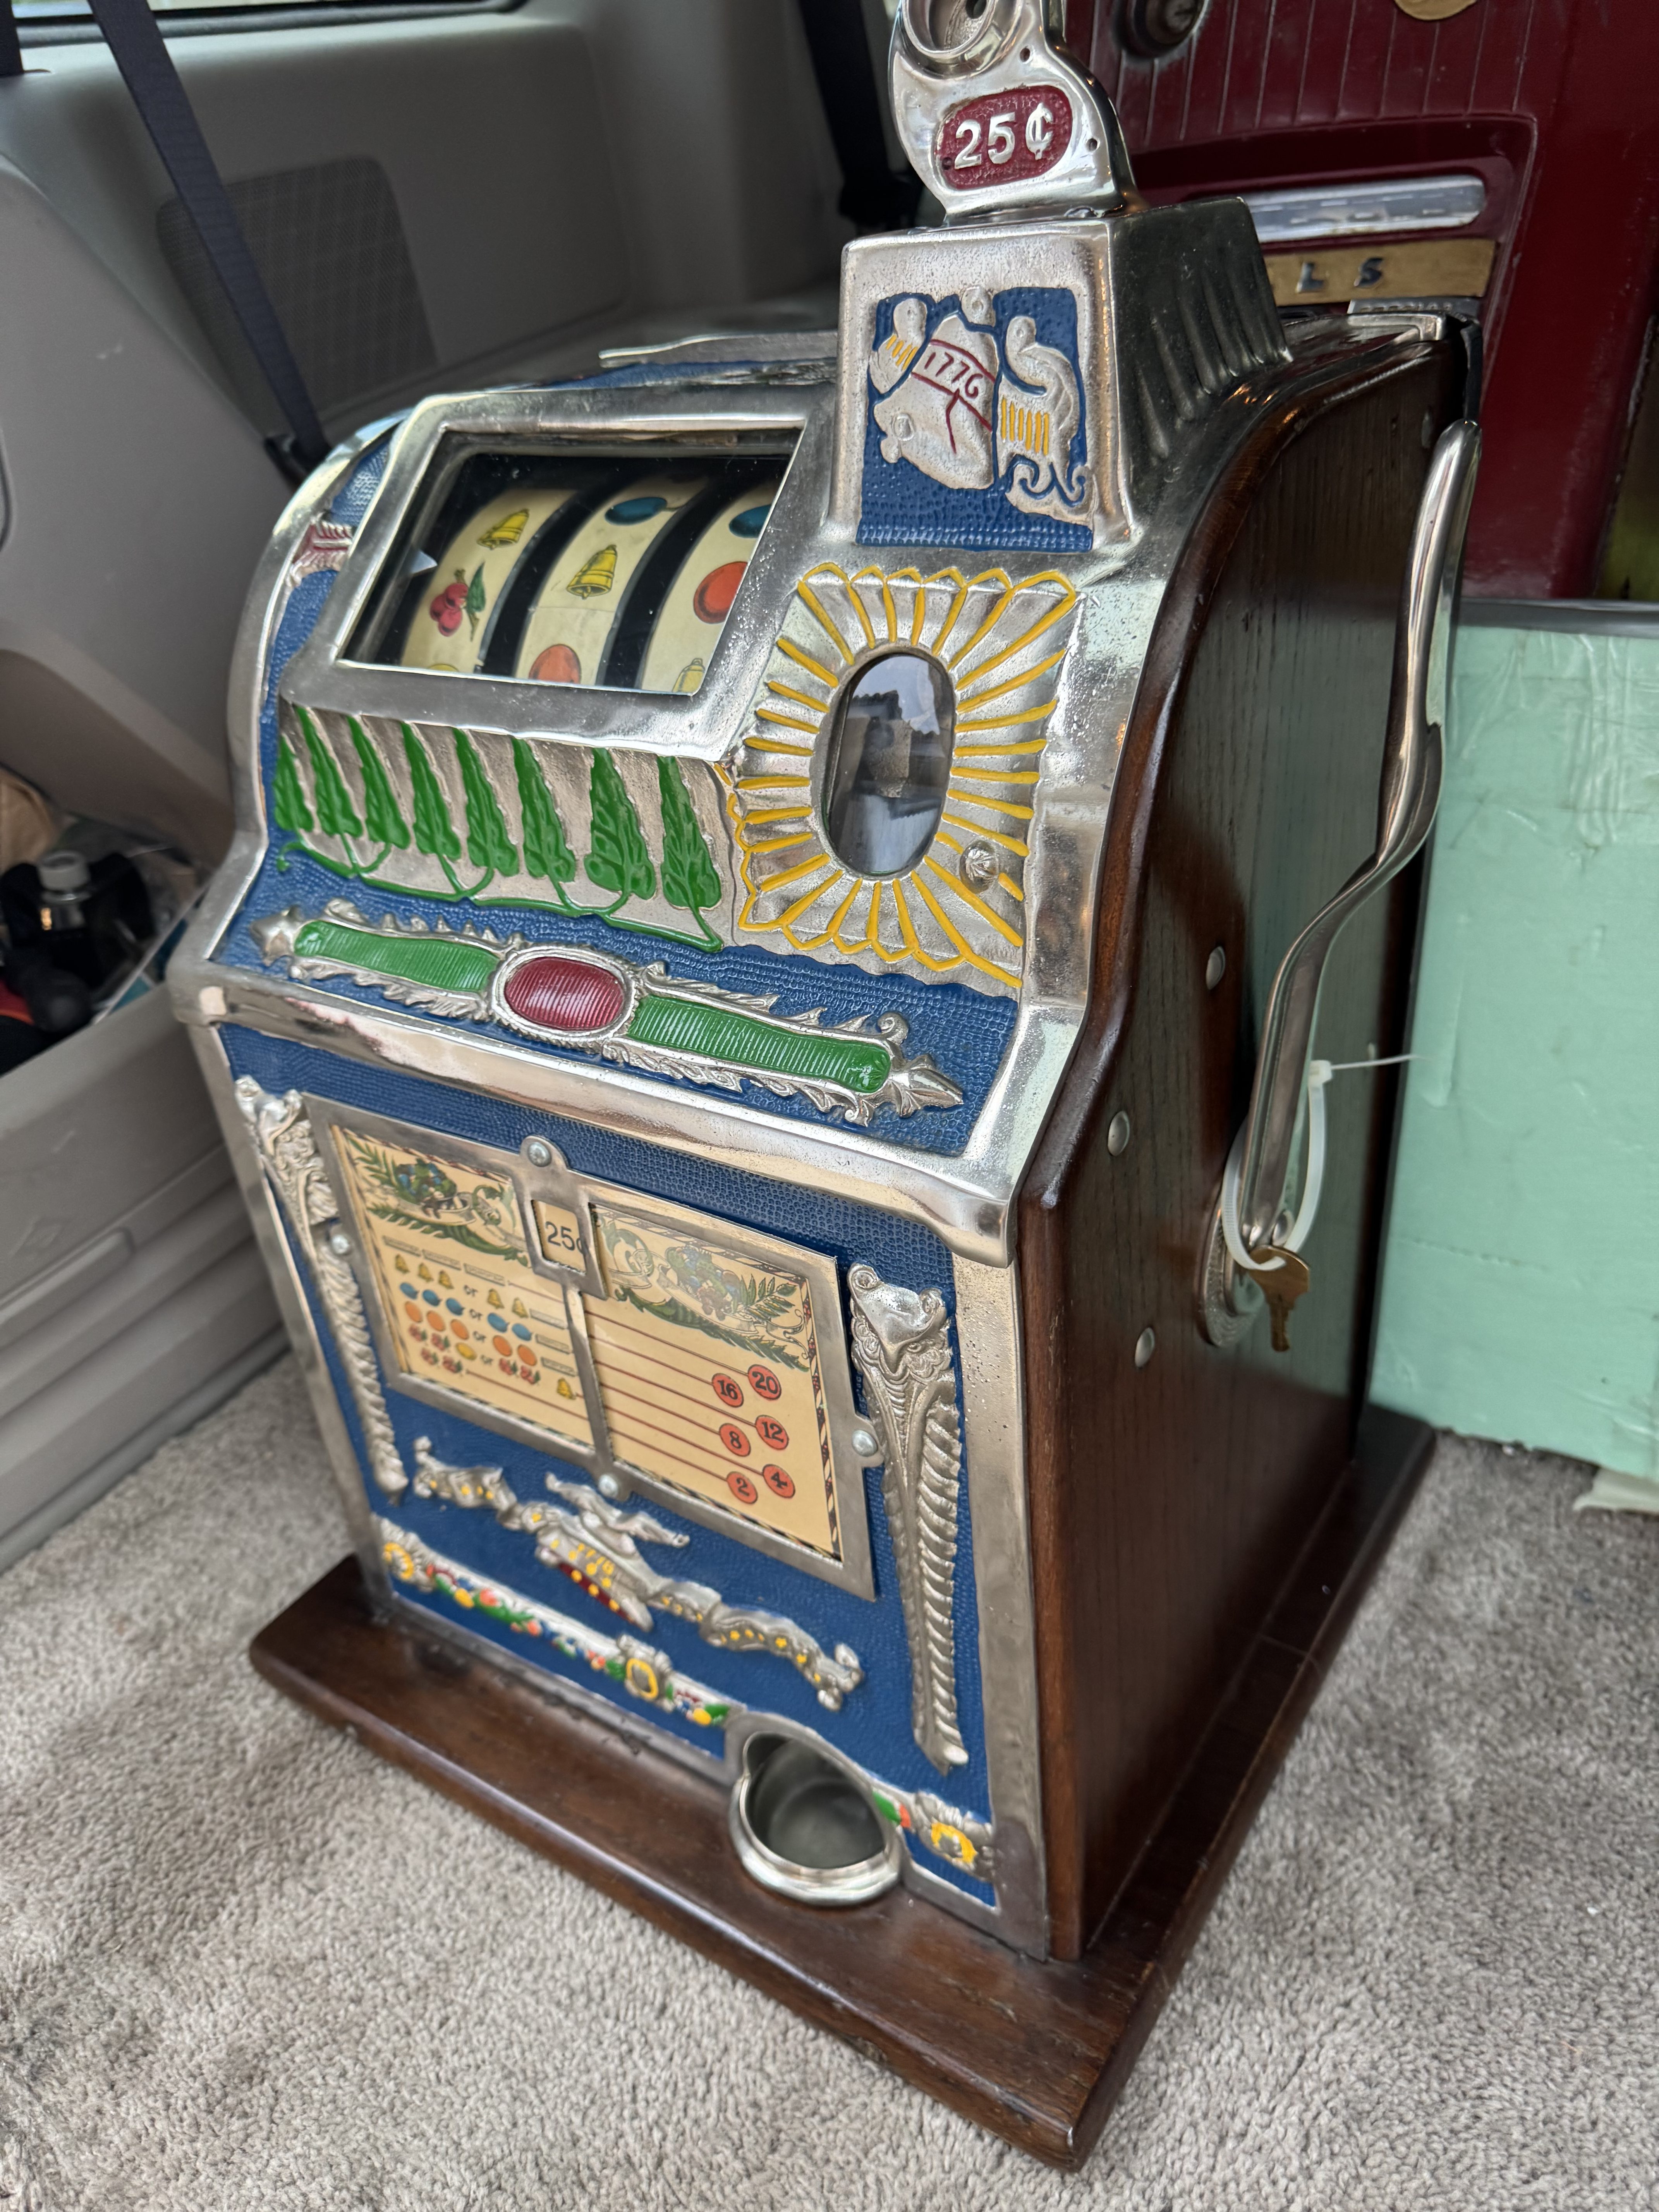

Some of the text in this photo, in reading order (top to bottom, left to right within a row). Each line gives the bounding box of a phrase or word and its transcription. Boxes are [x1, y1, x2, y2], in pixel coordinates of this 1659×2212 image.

[955, 103, 1053, 169] 25¢
[925, 353, 982, 398] 1776
[463, 1285, 478, 1297] or
[469, 1309, 483, 1321] or
[472, 1331, 486, 1343] or
[717, 1380, 738, 1400] 16
[752, 1371, 779, 1394] 20
[729, 1431, 742, 1449] 8
[761, 1421, 784, 1443] 12
[736, 1477, 750, 1496] 2
[771, 1472, 788, 1489] 4
